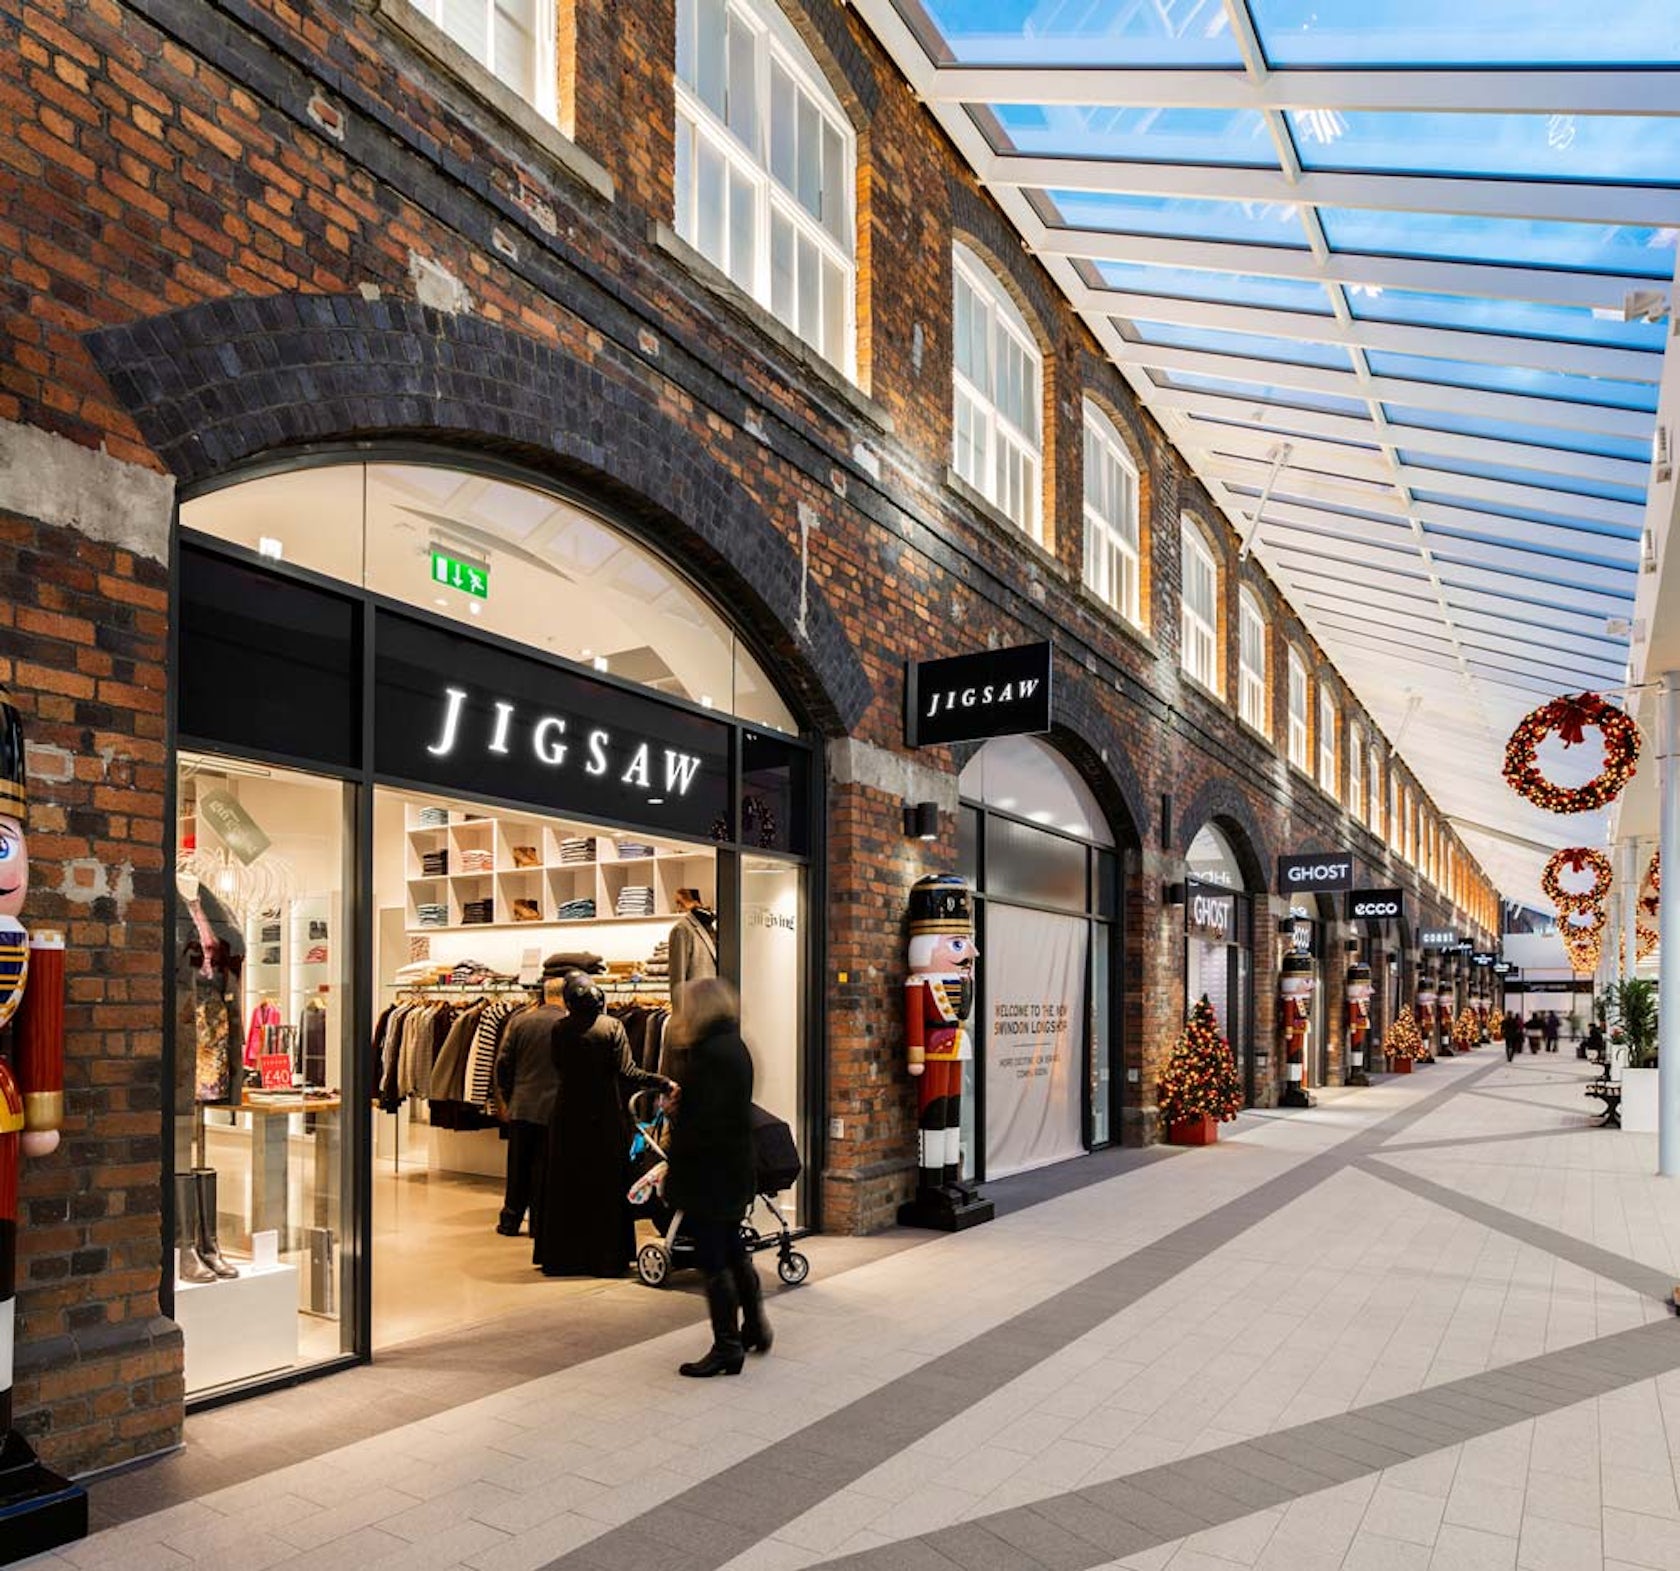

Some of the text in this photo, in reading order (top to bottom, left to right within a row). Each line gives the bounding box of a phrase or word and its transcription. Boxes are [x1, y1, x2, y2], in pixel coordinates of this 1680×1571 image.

[926, 678, 1040, 717] JIGSAW
[426, 687, 702, 797] JIGSAW
[1287, 862, 1350, 882] GHOST
[1193, 893, 1229, 930] GHOST
[1354, 902, 1399, 916] ecco
[994, 1004, 1029, 1017] WELCOME
[1031, 1004, 1041, 1018] TO
[1042, 1004, 1054, 1017] THE
[994, 1020, 1029, 1036] SWINDON
[264, 1069, 290, 1085] £40
